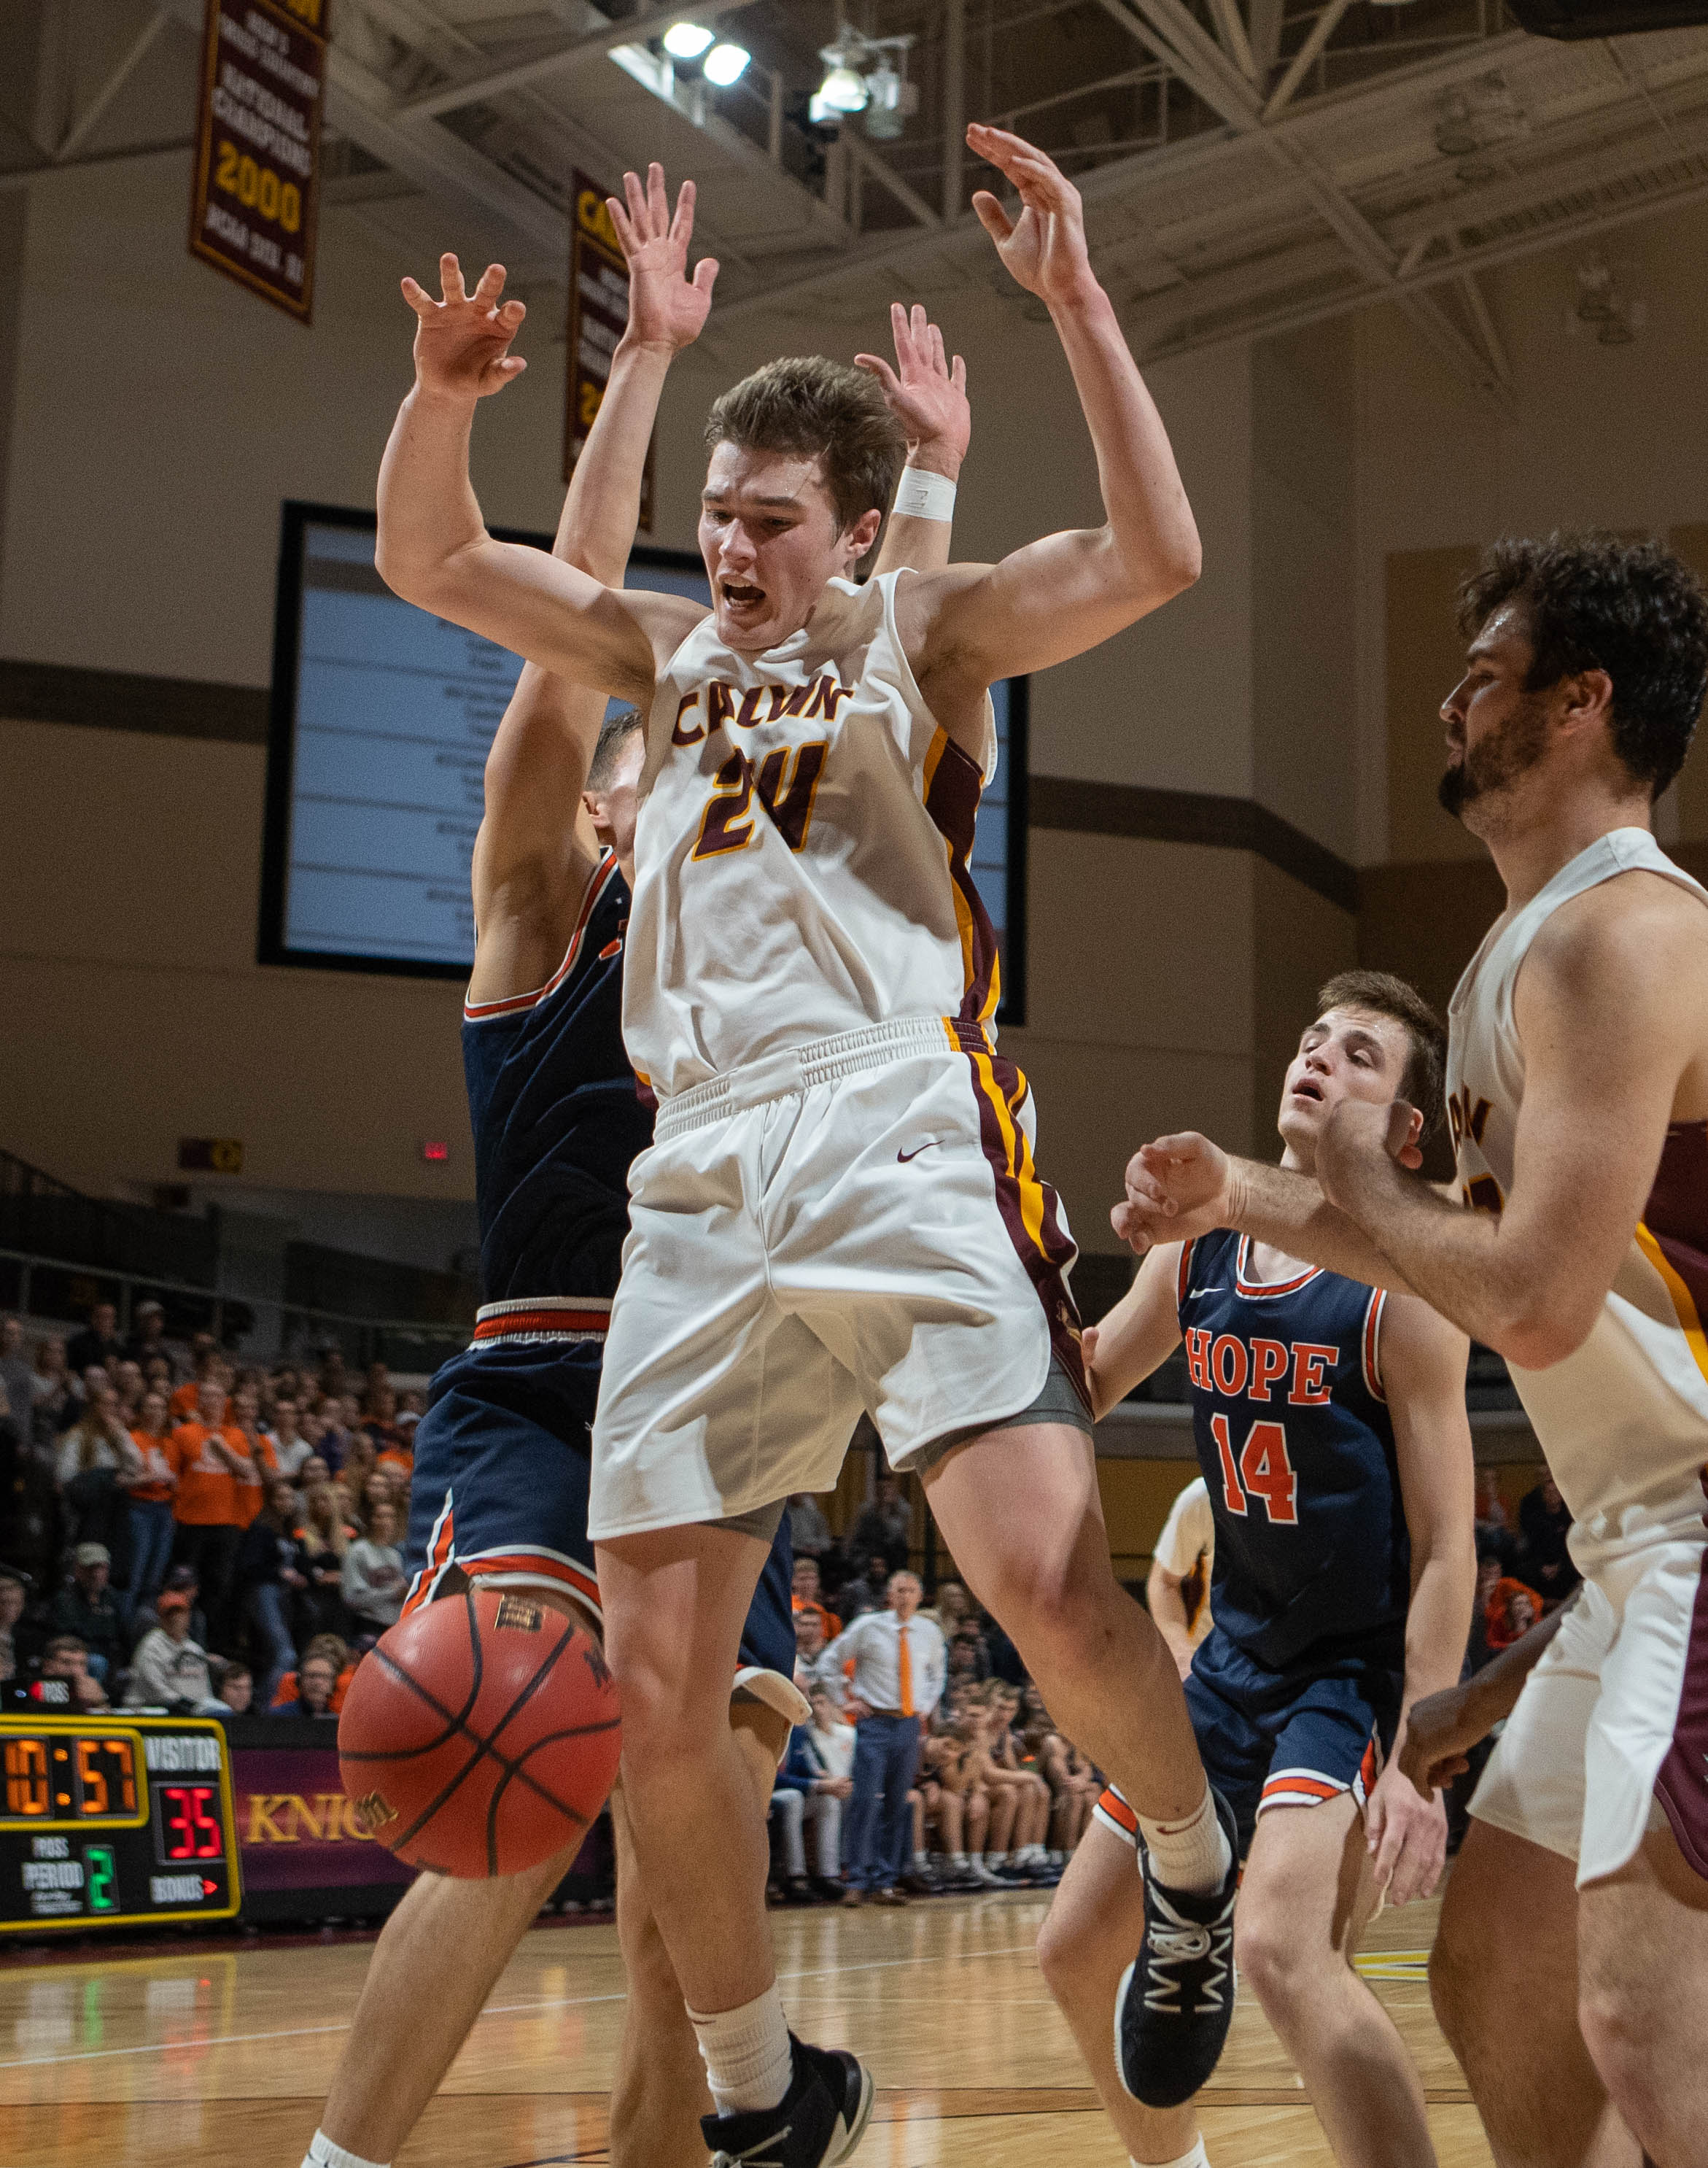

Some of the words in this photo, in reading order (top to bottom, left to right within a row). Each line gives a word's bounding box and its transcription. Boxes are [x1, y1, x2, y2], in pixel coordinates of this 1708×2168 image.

[211, 86, 312, 177] CHAMPIONS
[222, 62, 309, 142] NATIONAL
[216, 140, 300, 233] 2000
[691, 740, 829, 862] 24
[1184, 1326, 1340, 1406] HOPE
[1211, 1412, 1299, 1525] 14
[5, 1739, 136, 1815] 10:57
[145, 1735, 222, 1773] VISITOR
[165, 1787, 222, 1859] 35
[21, 1860, 85, 1891] PERIOD
[87, 1848, 114, 1909] 2
[149, 1873, 205, 1905] BONUS
